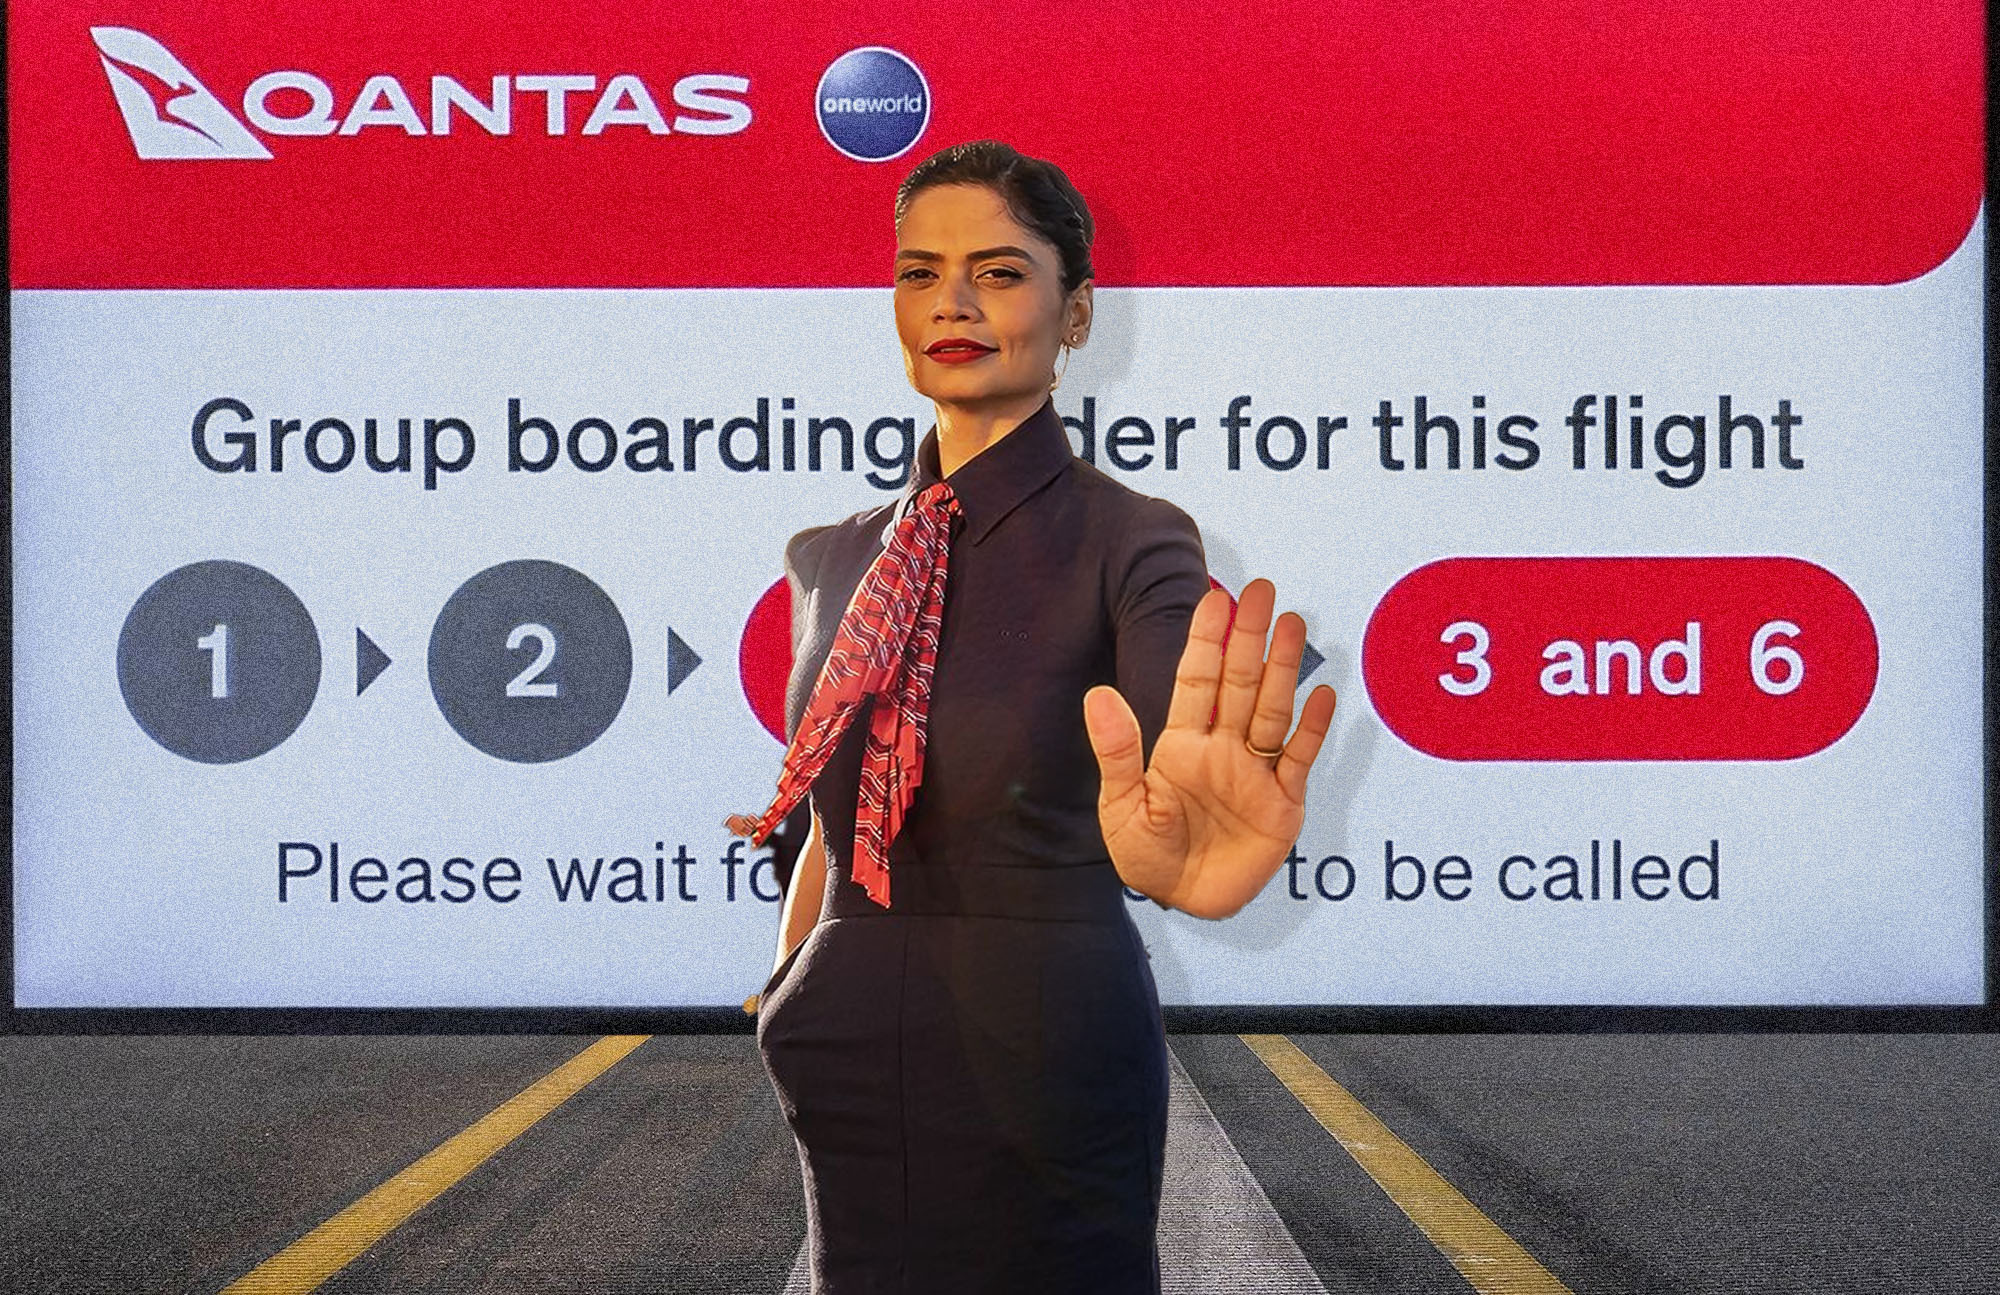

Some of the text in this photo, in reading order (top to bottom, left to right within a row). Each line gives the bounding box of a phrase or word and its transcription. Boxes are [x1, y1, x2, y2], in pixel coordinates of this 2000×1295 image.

[243, 71, 753, 136] QANTAS
[823, 94, 922, 113] oneworld
[191, 394, 1804, 491] Group boarding der for this flight
[197, 623, 229, 699] 1
[505, 622, 558, 698] 2
[1438, 620, 1804, 696] 3 and 6
[278, 839, 1719, 904] Please wait fo to be called
